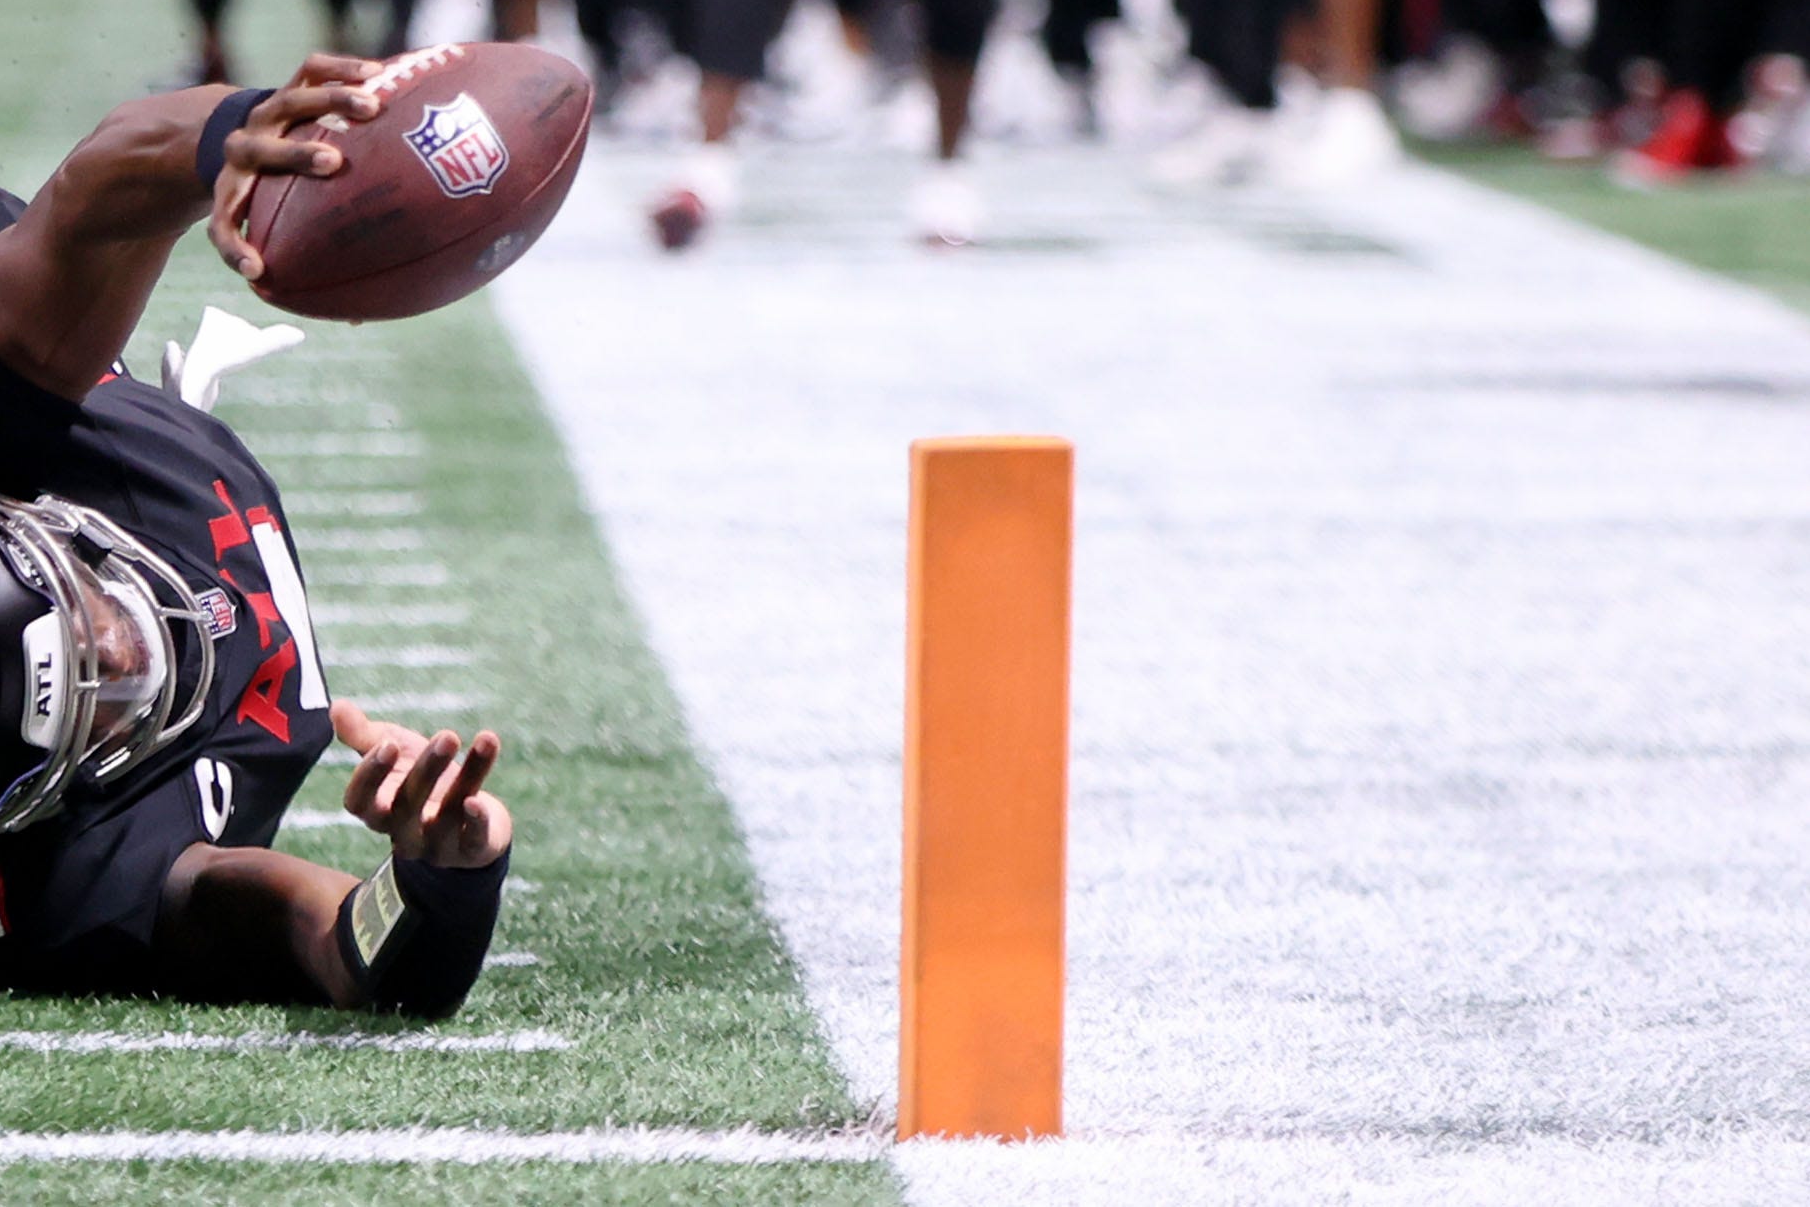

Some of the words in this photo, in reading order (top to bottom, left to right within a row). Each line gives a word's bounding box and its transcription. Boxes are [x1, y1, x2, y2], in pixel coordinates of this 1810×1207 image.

[435, 130, 501, 188] NFL
[212, 593, 233, 631] NFL
[35, 650, 53, 717] ATL
